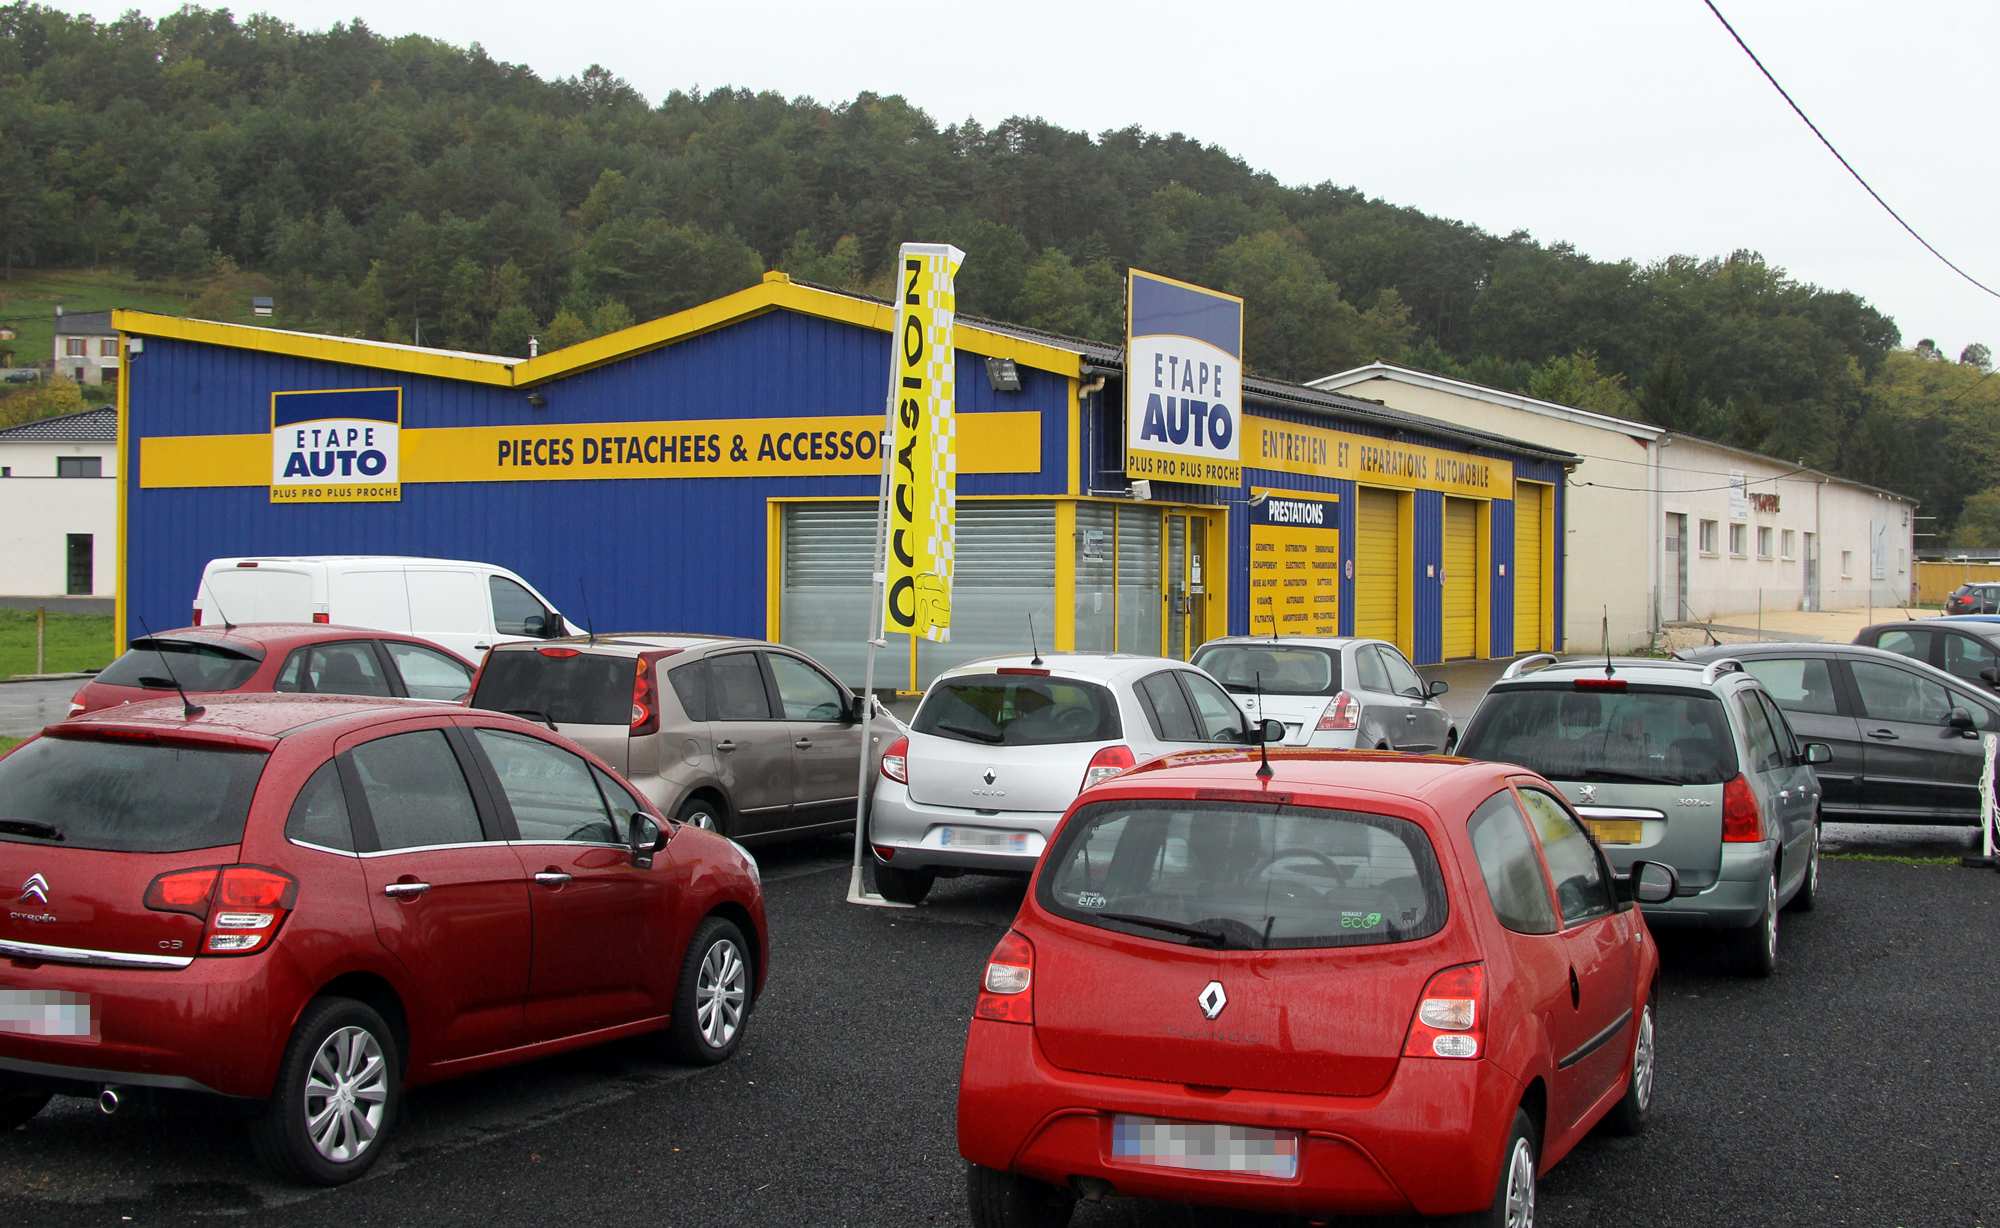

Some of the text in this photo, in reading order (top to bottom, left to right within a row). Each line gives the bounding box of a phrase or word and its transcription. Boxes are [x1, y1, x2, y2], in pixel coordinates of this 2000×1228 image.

[1154, 352, 1222, 398] ETAPE
[1140, 392, 1233, 450] AUTO
[296, 427, 374, 448] ETAPE
[498, 438, 574, 467] PIECES
[582, 433, 721, 465] DETACHEES
[729, 434, 749, 463] &
[889, 259, 923, 628] OCCASION
[283, 449, 387, 477] AUTO
[1129, 455, 1240, 481] PLUS PRO PLUS PROCHE
[1262, 429, 1490, 488] ENTRETIEN ET REPARATIONS AUTOMOBILE
[272, 487, 398, 498] PLUS PRO PLUS PROCHE
[1268, 500, 1324, 525] PRESTATIONS
[158, 939, 184, 950] C3
